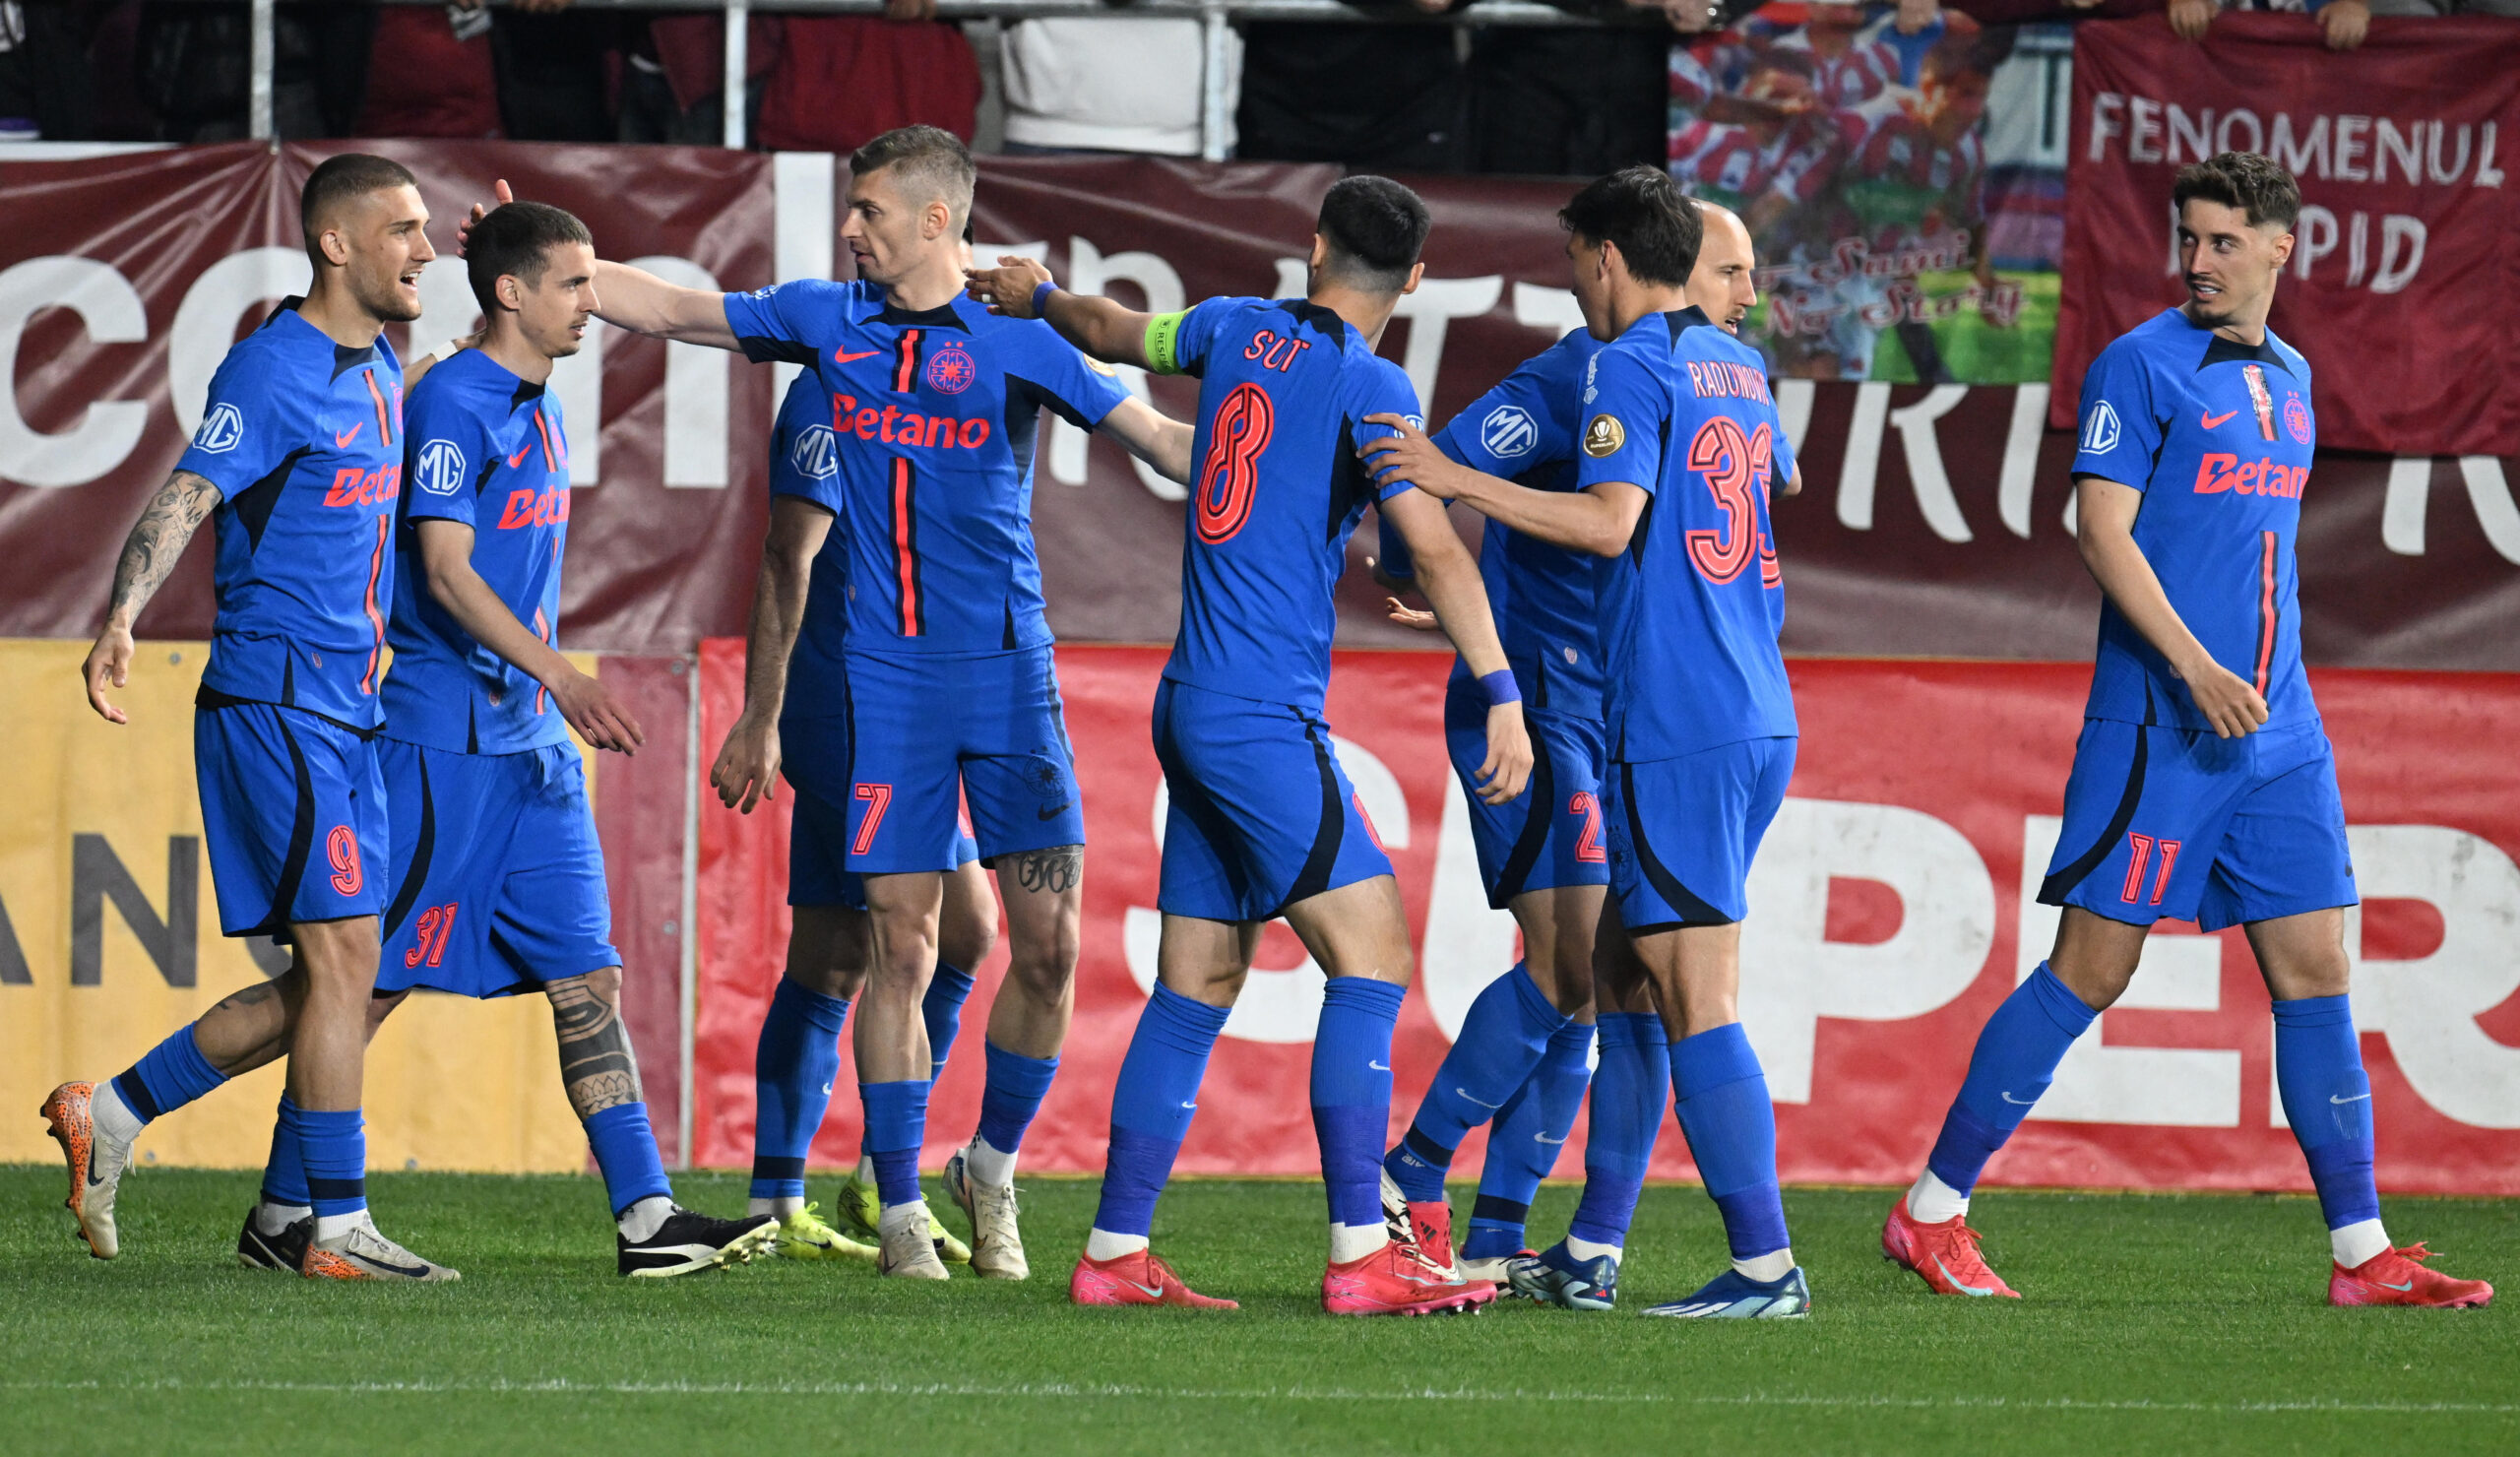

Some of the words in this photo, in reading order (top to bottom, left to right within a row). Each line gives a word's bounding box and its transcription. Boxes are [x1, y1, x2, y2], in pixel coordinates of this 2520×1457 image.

[2088, 91, 2505, 187] FENOMENUL
[795, 429, 837, 475] MG
[832, 391, 991, 450] Betano
[1485, 408, 1536, 456] MG
[417, 443, 463, 492] MG
[1194, 381, 1276, 545] 8
[850, 783, 893, 855] 7
[1568, 791, 1606, 863] 2
[326, 824, 363, 897] 9
[2119, 831, 2182, 906] 11
[405, 902, 459, 970] 31
